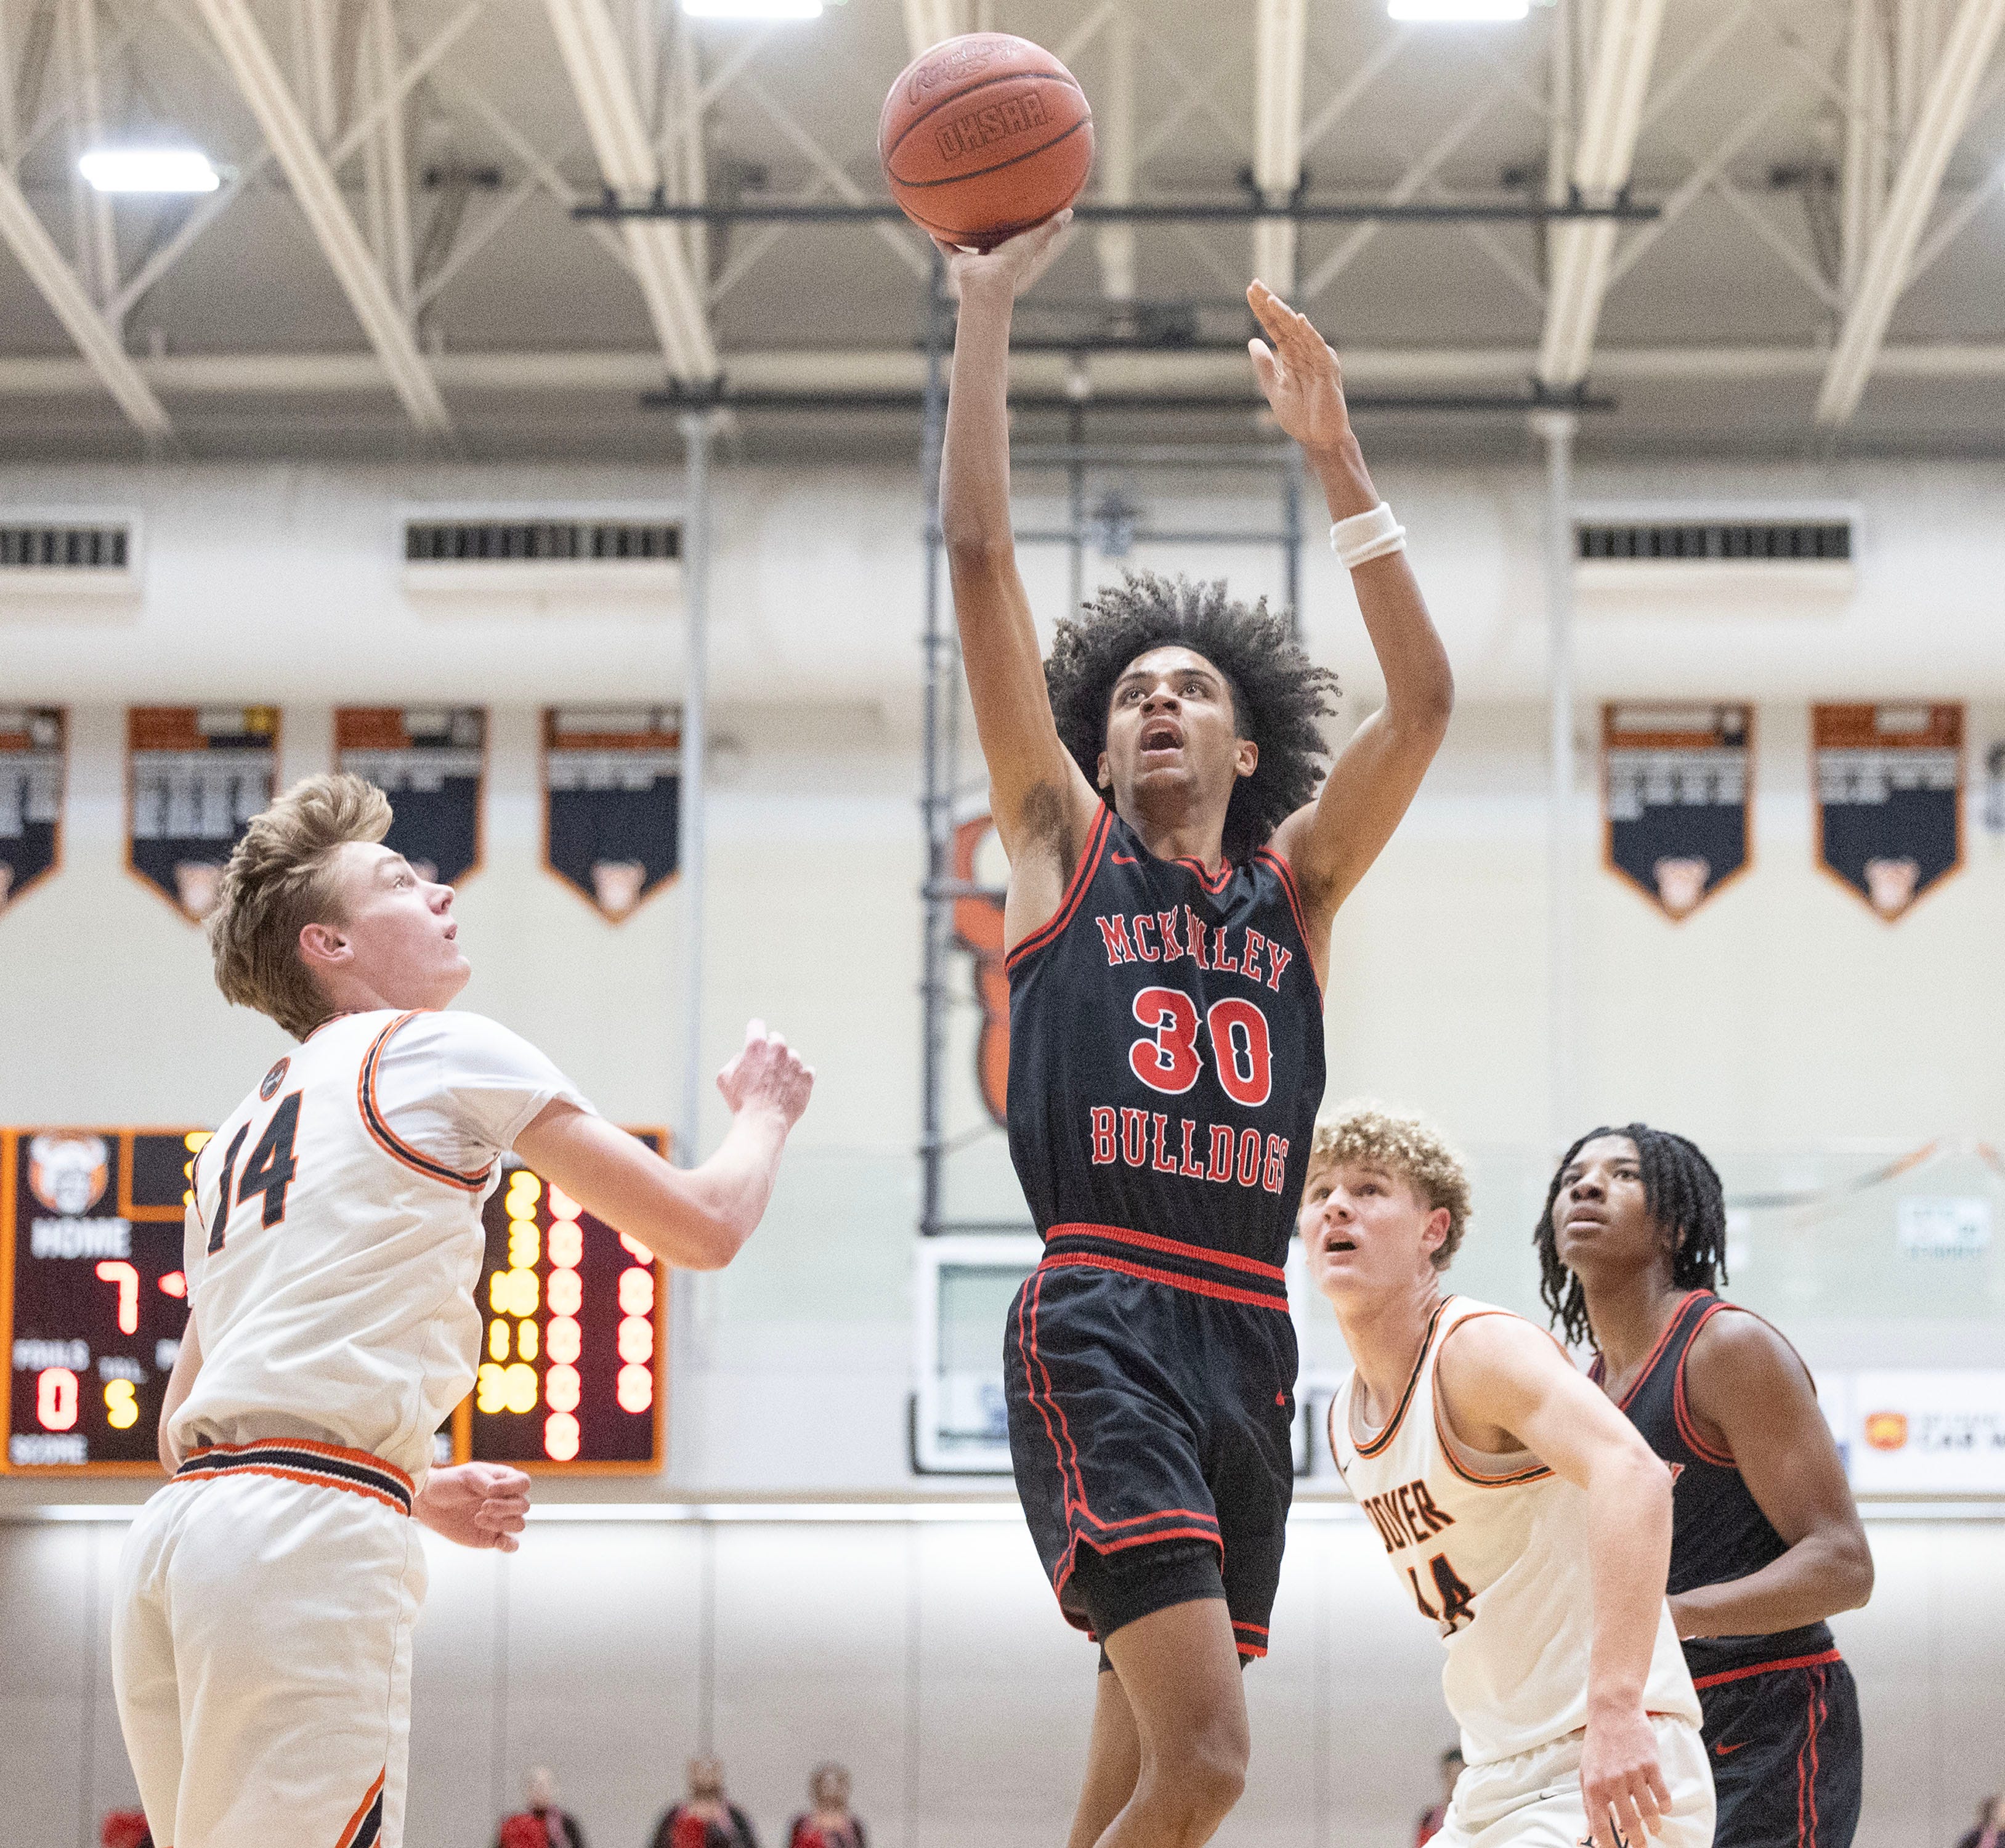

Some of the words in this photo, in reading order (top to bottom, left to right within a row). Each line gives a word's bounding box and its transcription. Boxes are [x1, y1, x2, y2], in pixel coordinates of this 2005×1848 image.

[934, 91, 1049, 162] OHSAA
[1129, 986, 1273, 1108] 30
[208, 1088, 304, 1257] 14
[1090, 1106, 1290, 1195] BULLDOGS
[95, 1261, 139, 1335] 7
[37, 1368, 79, 1430] 0
